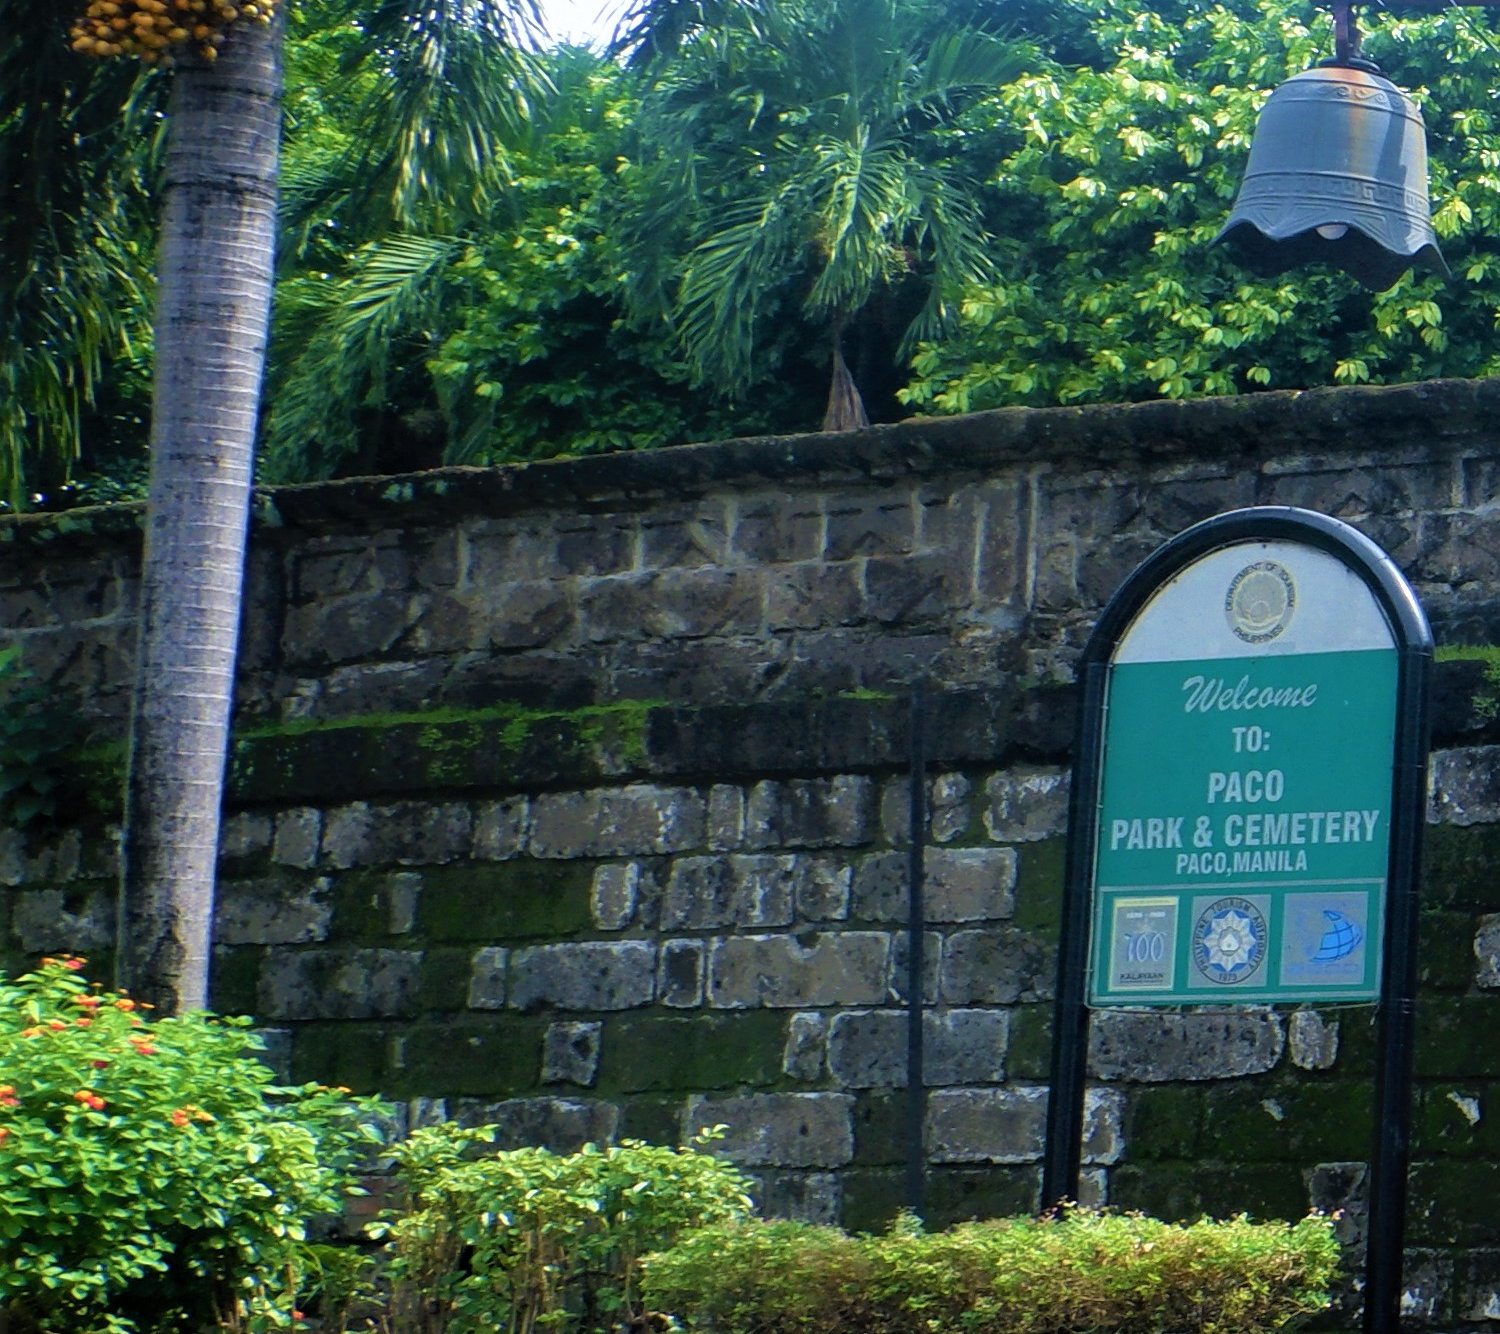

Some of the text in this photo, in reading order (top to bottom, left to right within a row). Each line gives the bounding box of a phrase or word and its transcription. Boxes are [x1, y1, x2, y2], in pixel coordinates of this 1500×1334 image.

[1182, 674, 1318, 714] Welcome
[1232, 726, 1271, 753] TO:
[1207, 769, 1284, 804] PACO
[1111, 809, 1380, 851] PARK & CEMETERY
